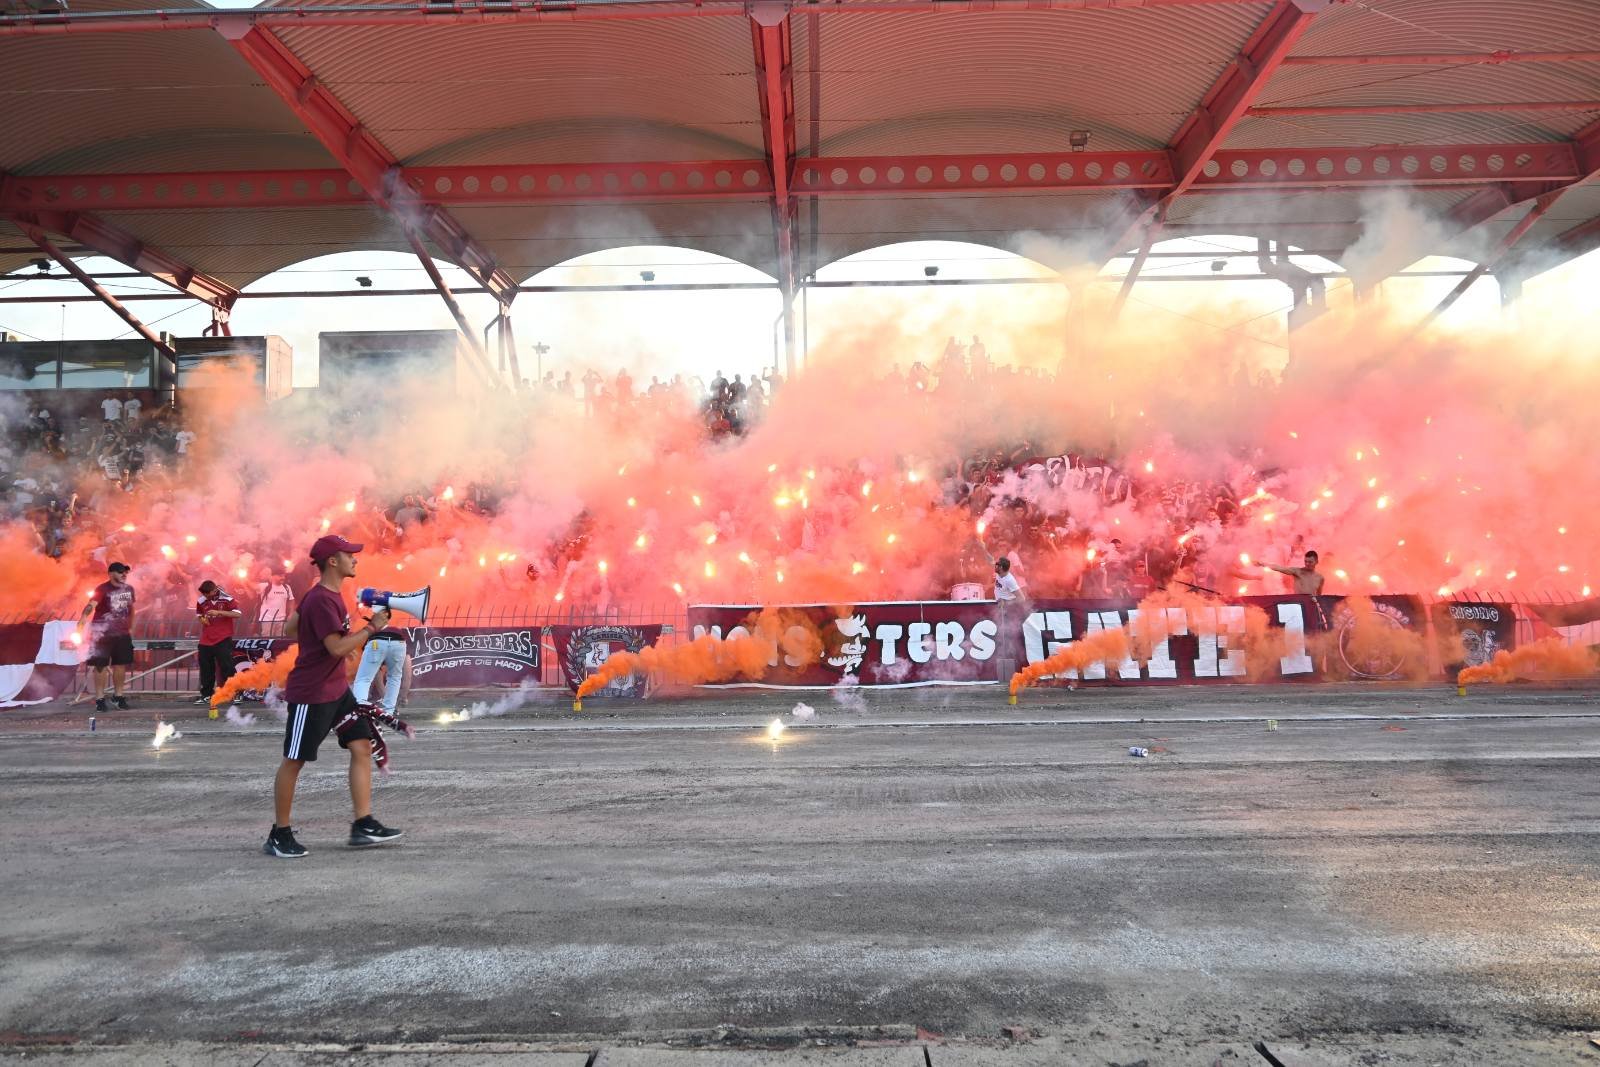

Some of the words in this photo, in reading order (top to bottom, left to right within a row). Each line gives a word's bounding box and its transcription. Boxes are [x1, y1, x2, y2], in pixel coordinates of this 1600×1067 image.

[1449, 606, 1499, 622] RISING
[1022, 605, 1247, 679] GATE
[1277, 603, 1314, 675] 1
[413, 664, 433, 676] OLD
[435, 658, 472, 671] HABITS
[475, 658, 492, 666] DIE
[495, 658, 524, 672] HARD
